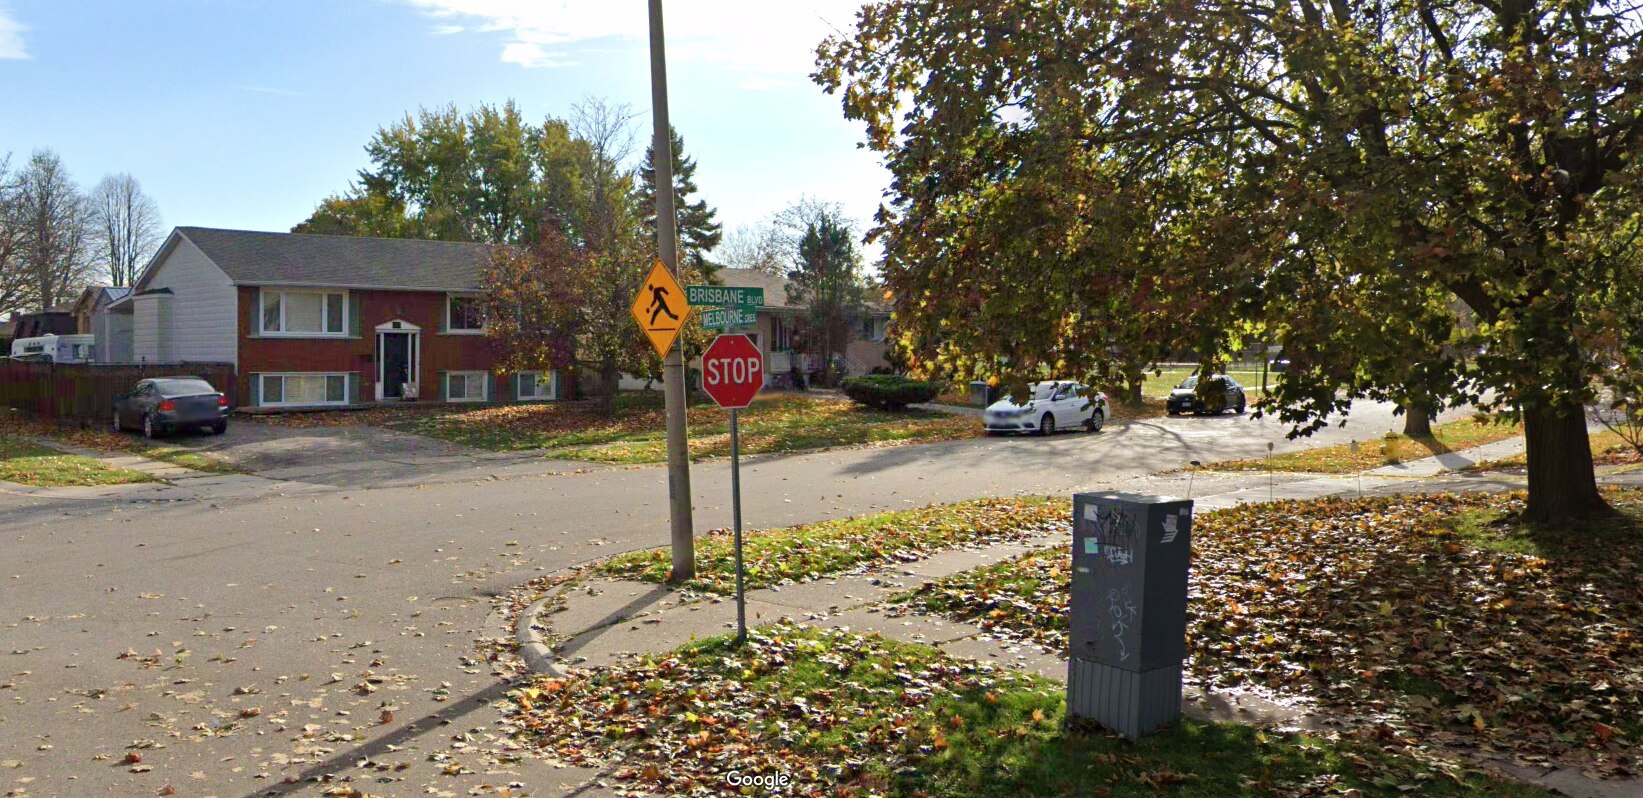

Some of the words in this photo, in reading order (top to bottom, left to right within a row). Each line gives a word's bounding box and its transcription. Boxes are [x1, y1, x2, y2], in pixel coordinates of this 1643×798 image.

[690, 288, 744, 304] BRISBANE
[746, 295, 763, 304] BLVD
[703, 309, 743, 327] MELBOURNE
[744, 313, 756, 323] CRES
[707, 357, 760, 385] STOP
